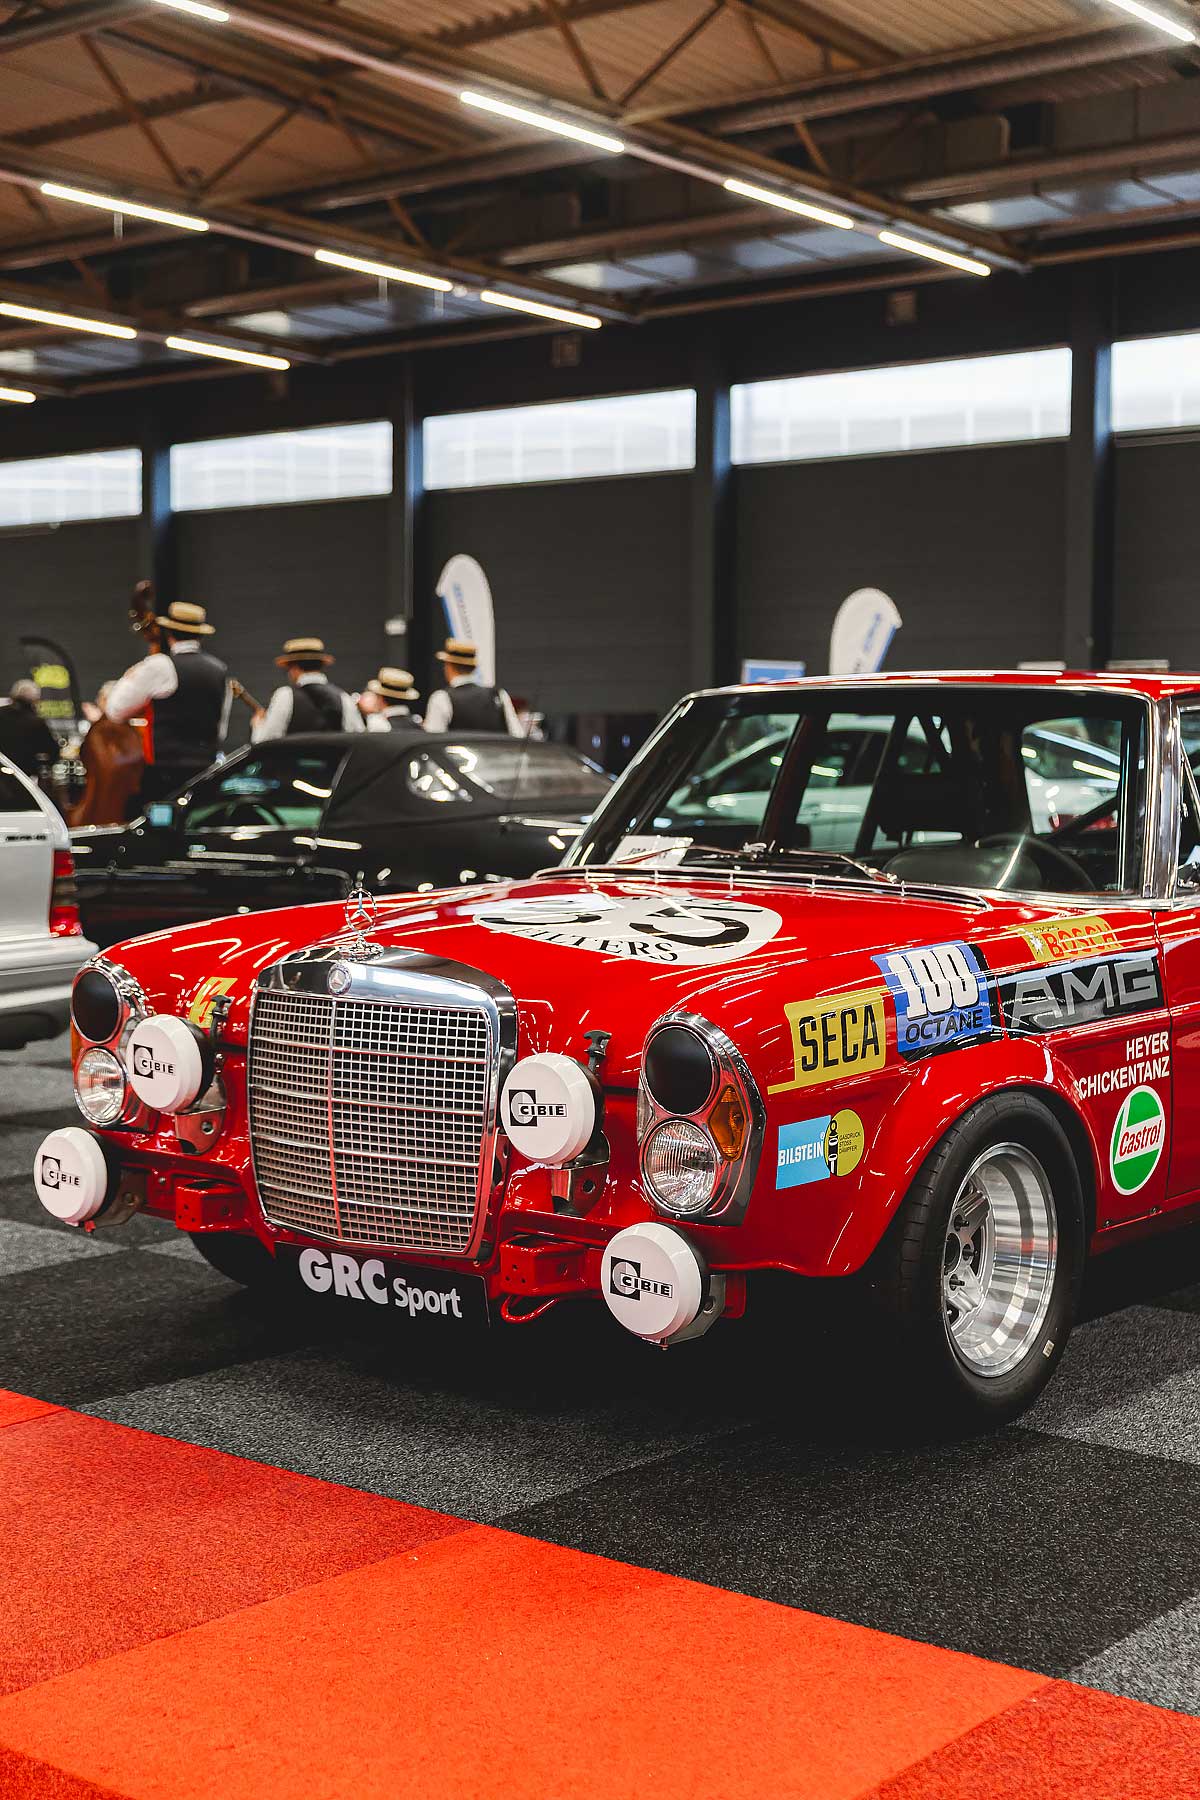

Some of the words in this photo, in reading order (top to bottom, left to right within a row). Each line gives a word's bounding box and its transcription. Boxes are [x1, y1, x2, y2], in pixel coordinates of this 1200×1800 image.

[511, 928, 679, 962] FILTERS
[1041, 924, 1119, 958] BOSCH
[886, 944, 978, 1020] 100
[1011, 959, 1158, 1028] AMG
[799, 1005, 880, 1072] SECA
[905, 1009, 983, 1044] OCTANE
[1126, 1031, 1169, 1061] HEYER
[777, 1141, 824, 1167] BILSTEIN
[1119, 1120, 1162, 1157] Castrol
[299, 1248, 388, 1305] GRC
[393, 1278, 462, 1318] Sport
